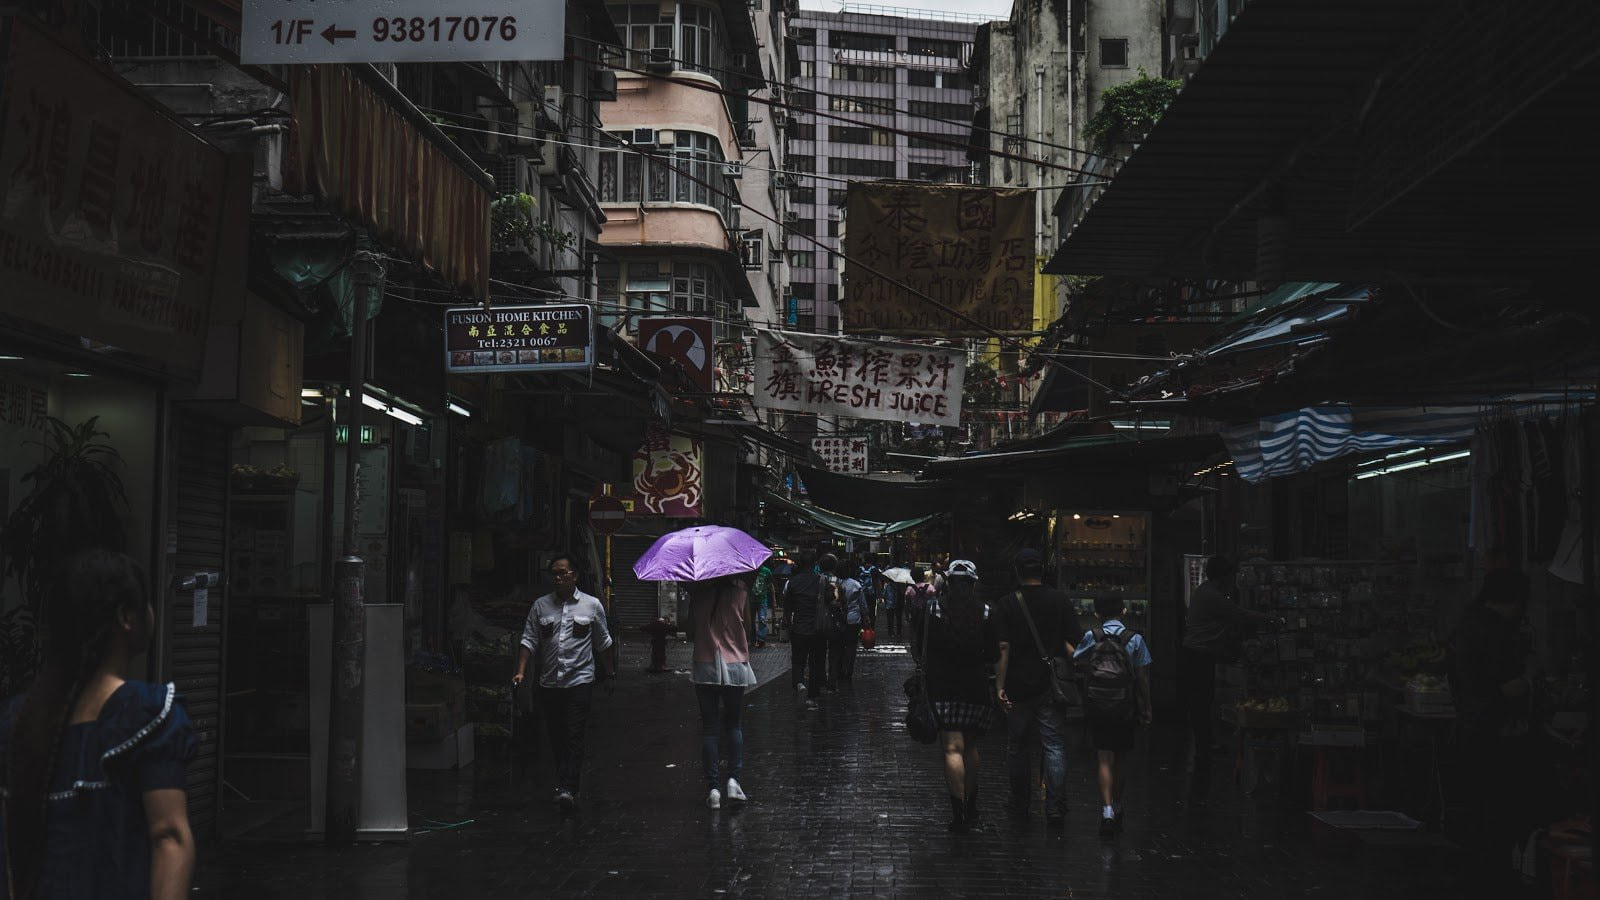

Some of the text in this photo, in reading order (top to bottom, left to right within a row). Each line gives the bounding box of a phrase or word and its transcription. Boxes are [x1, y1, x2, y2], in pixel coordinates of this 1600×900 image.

[269, 16, 517, 44] 1/F 93817076
[876, 190, 997, 235] 泰國
[451, 309, 584, 325] FUSION HOME KITCHEN
[468, 322, 568, 338] 南亞混合食品
[477, 337, 558, 349] Tel:2321 0067
[807, 379, 881, 408] FRESH
[851, 440, 866, 472] 新利
